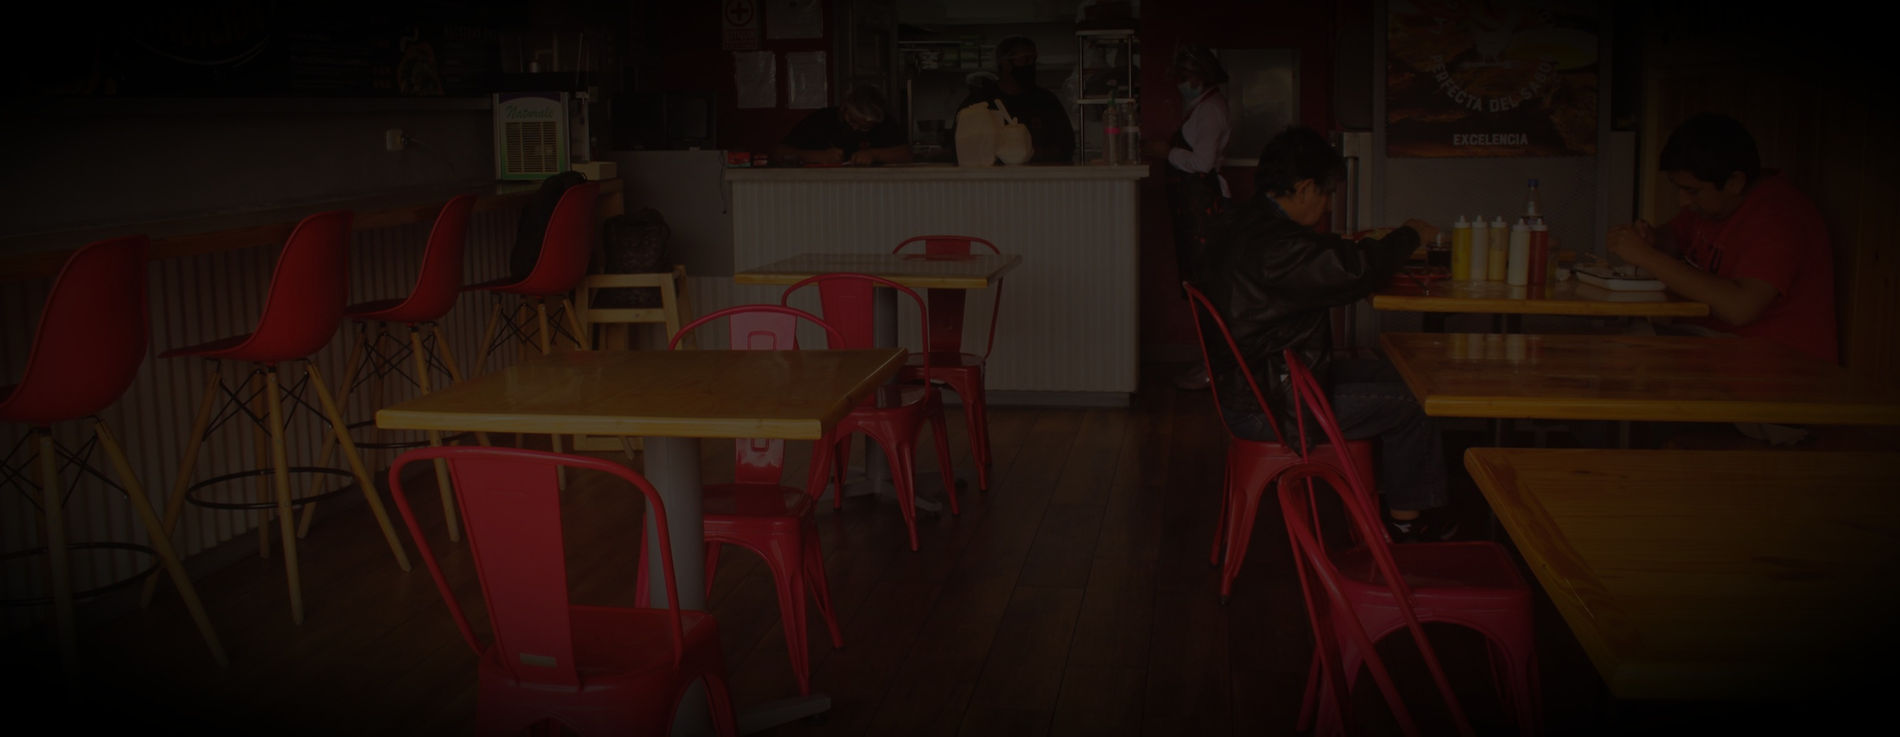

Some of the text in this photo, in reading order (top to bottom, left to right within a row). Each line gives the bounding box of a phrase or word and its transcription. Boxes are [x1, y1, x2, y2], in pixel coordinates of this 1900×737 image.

[1430, 55, 1483, 112] PERFECTA
[1489, 96, 1520, 112] DEL
[1452, 133, 1529, 146] EXCELENCIA
